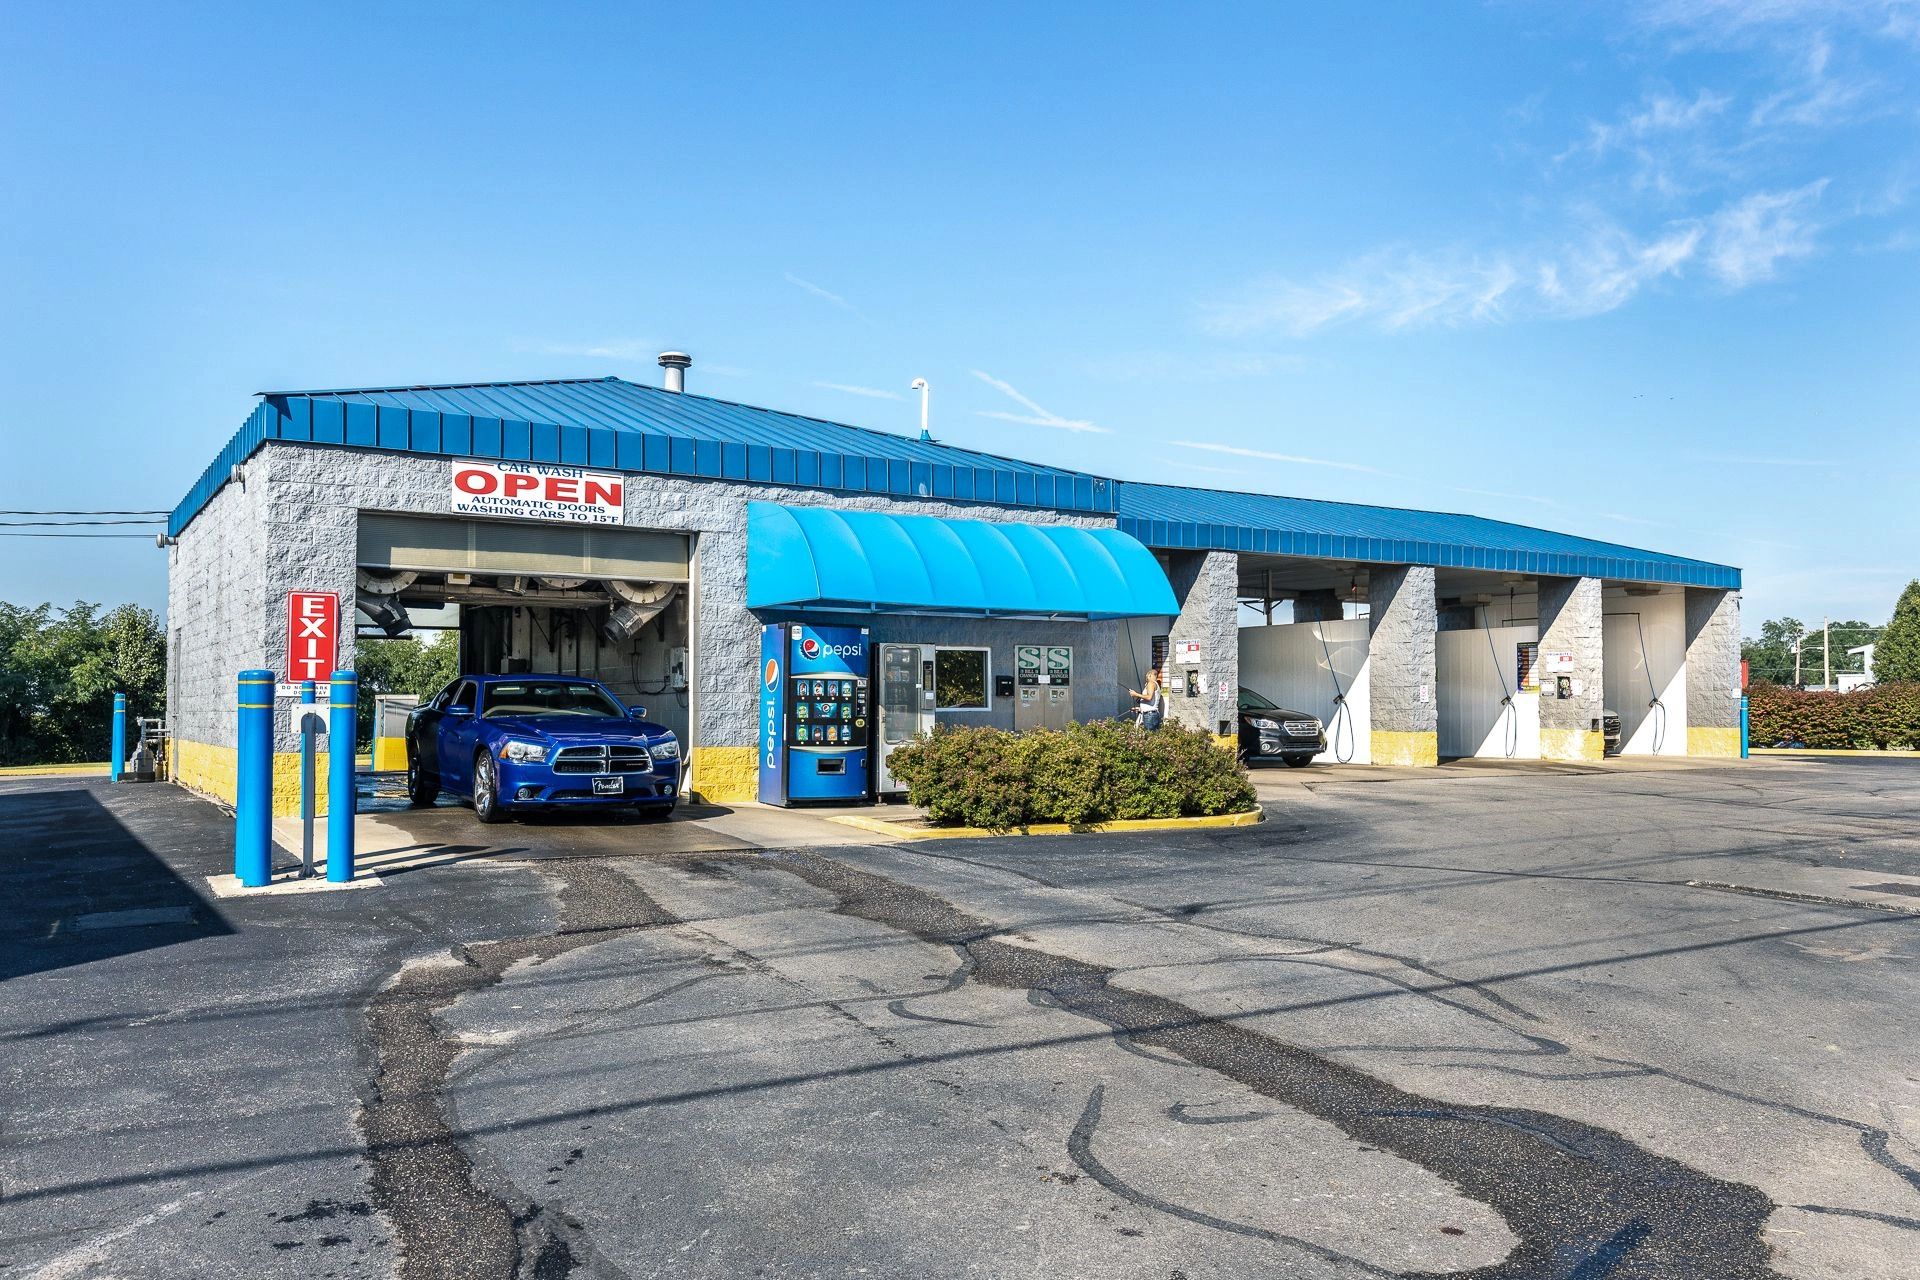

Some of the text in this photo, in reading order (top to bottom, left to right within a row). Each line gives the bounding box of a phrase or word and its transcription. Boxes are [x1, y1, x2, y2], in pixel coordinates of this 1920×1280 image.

[497, 461, 584, 478] CAR WASH
[454, 469, 622, 507] OPEN
[457, 504, 524, 516] WASHING
[529, 509, 565, 520] CARS
[571, 512, 588, 522] TO
[471, 496, 606, 514] AUTOMATIC DOORS
[298, 597, 327, 679] EXIT
[822, 643, 861, 659] pepsi
[767, 697, 776, 769] pepsi
